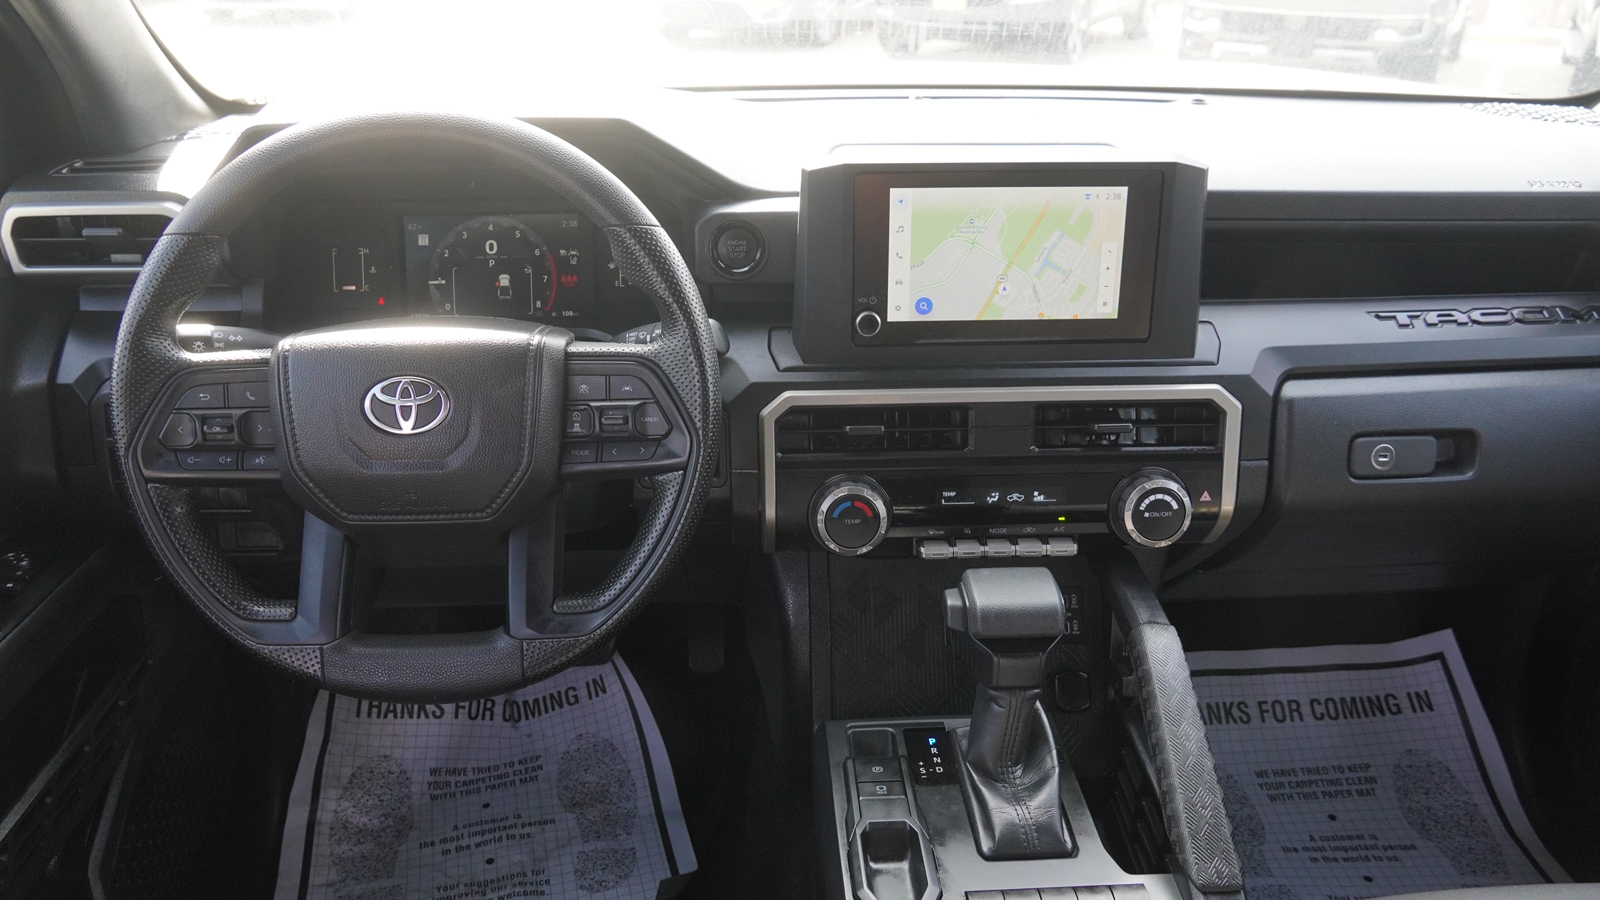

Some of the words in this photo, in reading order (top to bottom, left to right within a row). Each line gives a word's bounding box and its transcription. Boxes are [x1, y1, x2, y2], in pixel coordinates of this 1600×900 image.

[462, 231, 468, 239] 3
[515, 230, 521, 238] 5
[443, 249, 449, 257] 2
[485, 239, 498, 254] 0
[534, 248, 540, 256] 6
[489, 259, 495, 268] P
[542, 275, 548, 283] 7
[536, 300, 542, 308] 8
[356, 699, 445, 719] THANKS
[454, 699, 496, 721] FOR
[502, 686, 580, 723] COMING
[585, 674, 607, 700] IN
[1257, 699, 1304, 724] FOR
[1309, 693, 1403, 721] COMING
[1406, 690, 1434, 714] IN
[928, 737, 936, 745] P
[429, 767, 444, 777] WE
[445, 767, 469, 777] HAVE
[471, 764, 500, 776] TRIED
[503, 760, 515, 770] TO
[518, 755, 542, 766] KEEP
[1254, 769, 1271, 779] WE
[1271, 767, 1298, 778] HAVE
[1300, 765, 1329, 776] TRIED
[1331, 764, 1345, 774] TO
[1346, 763, 1372, 773] KEEP
[427, 780, 452, 791] YOUR
[455, 772, 510, 789] CARPETING
[513, 764, 544, 777] CLEAN
[1257, 781, 1286, 791] YOUR
[1287, 778, 1344, 789] CARPETING
[1345, 776, 1378, 786] CLEAN
[430, 791, 456, 801] WITH
[460, 787, 482, 797] THIS
[485, 779, 516, 792] PAPER
[519, 775, 539, 785] MAT
[1267, 792, 1294, 802] WITH
[1295, 791, 1320, 801] THIS
[1321, 789, 1354, 800] PAPER
[1355, 787, 1377, 797] MAT
[462, 815, 510, 829] customer
[419, 841, 436, 849] the
[439, 832, 465, 845] most
[468, 821, 518, 838] important
[521, 818, 556, 830] person
[1309, 834, 1317, 842] A
[1318, 833, 1365, 842] customer
[1368, 832, 1378, 840] is
[441, 847, 452, 856] in
[455, 844, 472, 853] the
[474, 835, 503, 849] world
[506, 832, 516, 841] to
[1329, 843, 1379, 853] important
[1381, 843, 1418, 852] person
[1321, 855, 1339, 863] the
[1341, 855, 1372, 863] world
[1372, 854, 1383, 862] to
[436, 882, 460, 893] Your
[463, 872, 528, 888] suggestions
[531, 868, 546, 878] for
[490, 884, 508, 893] our
[512, 878, 551, 888] service
